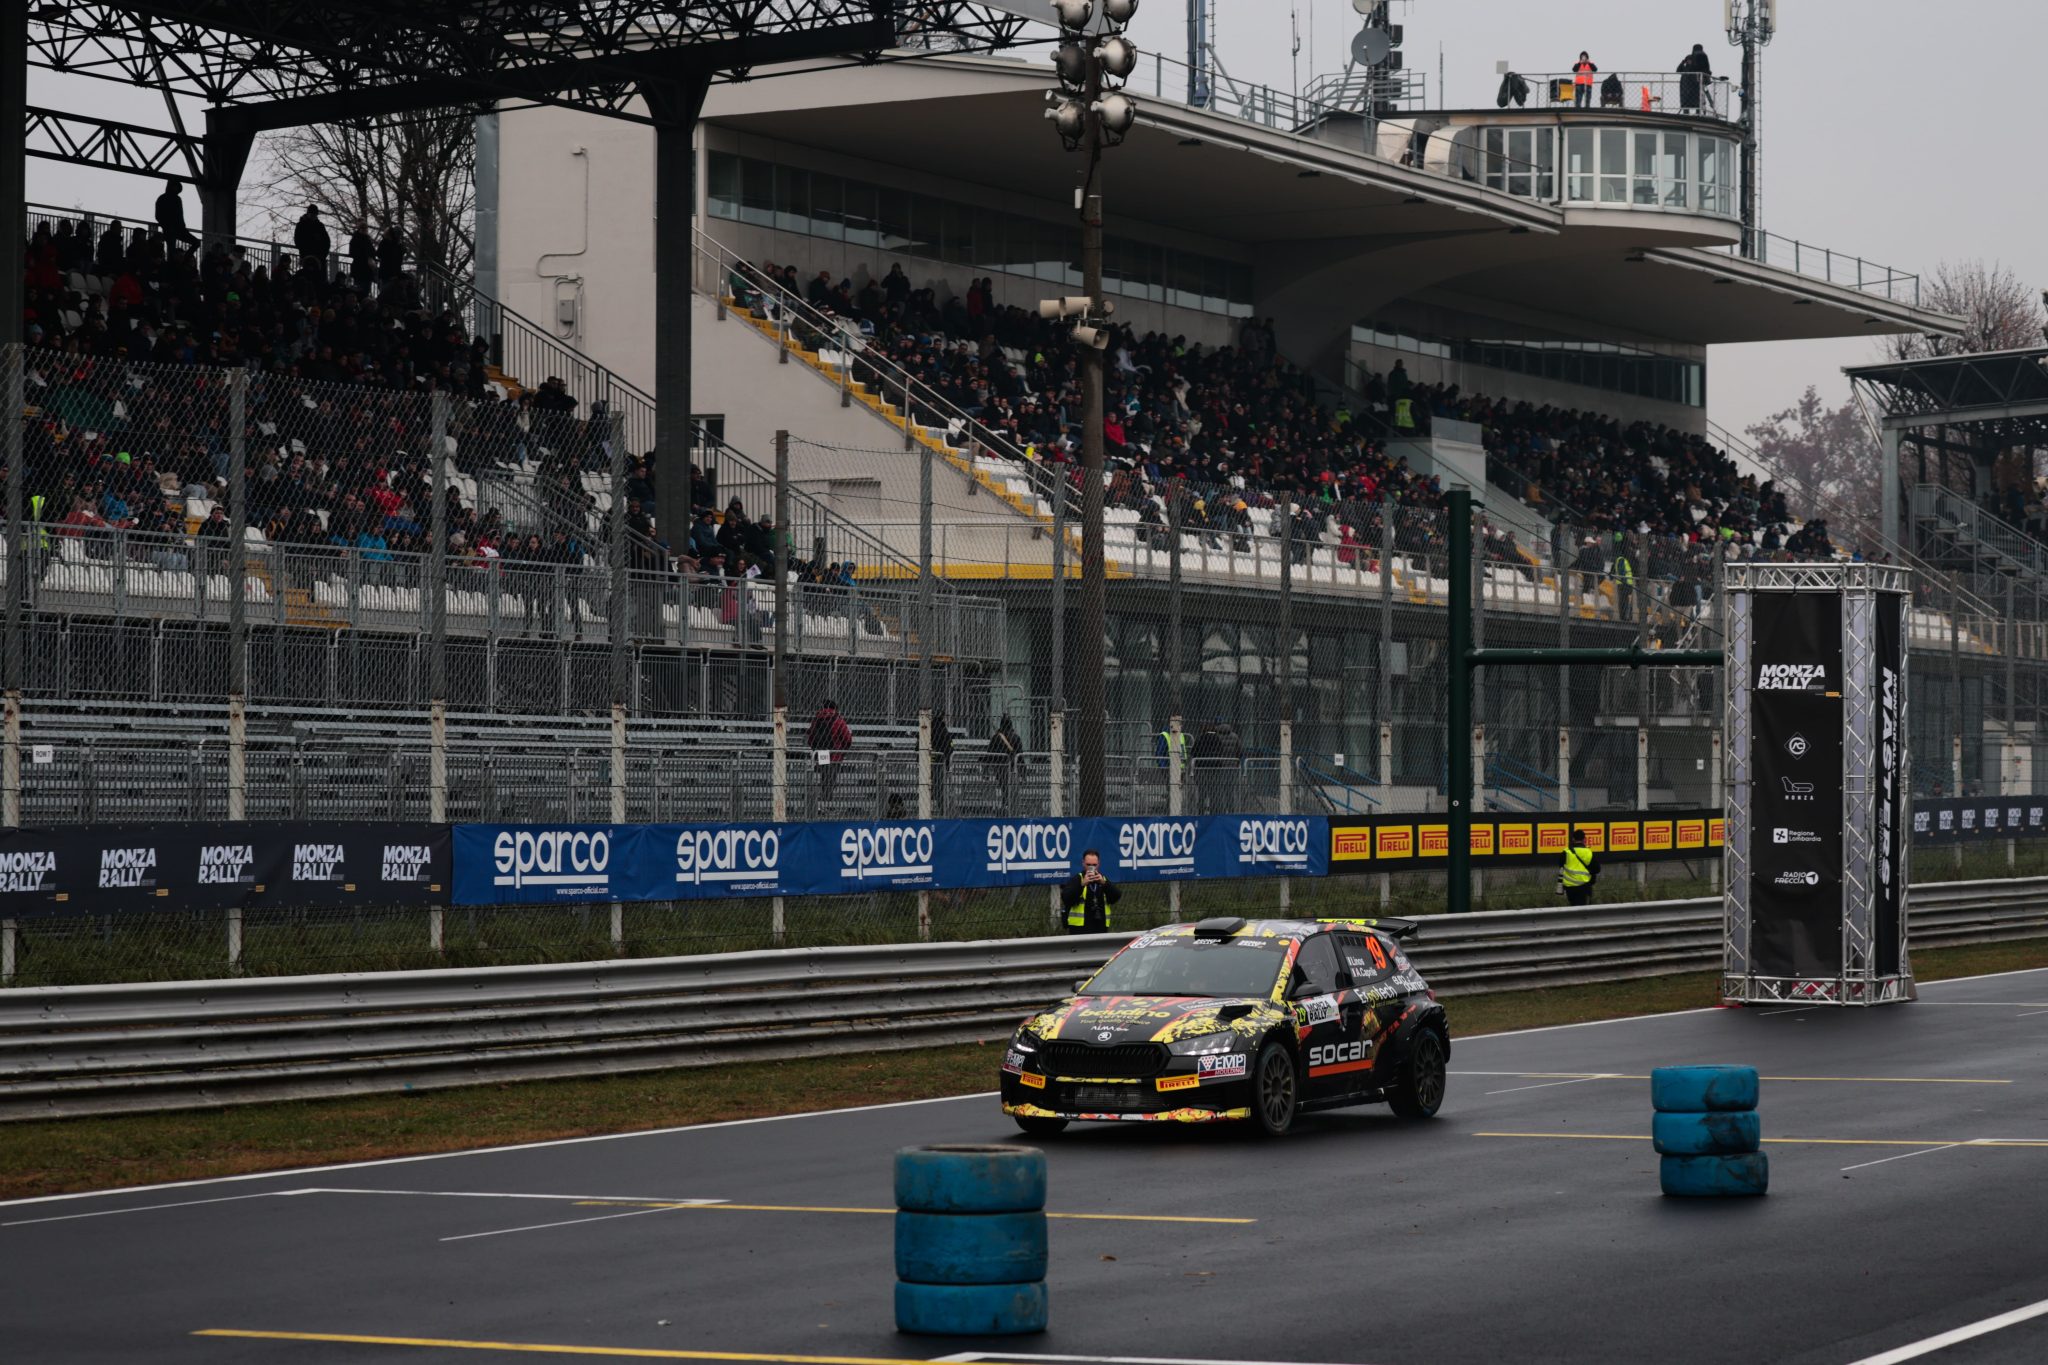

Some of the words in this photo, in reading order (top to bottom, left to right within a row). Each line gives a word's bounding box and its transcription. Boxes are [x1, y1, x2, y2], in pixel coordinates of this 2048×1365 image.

[1760, 664, 1825, 678] MONZA
[1757, 677, 1812, 690] RALLY
[1239, 819, 1308, 864] sparco
[1335, 834, 1367, 854] PIRELLI
[1379, 832, 1410, 852] PIRELLI
[1502, 829, 1530, 848] PIRELLI
[1540, 828, 1566, 847] PIRELLI
[1611, 827, 1637, 845] PIRELLI
[1645, 826, 1670, 844] PIRELLI
[1679, 825, 1702, 843] PIRELLI
[200, 845, 254, 865] MONZA
[293, 844, 344, 864] MONZA
[383, 845, 431, 865] MONZA
[840, 826, 933, 879] sparco
[987, 824, 1070, 874] sparco
[1119, 821, 1196, 869] sparco
[0, 851, 56, 873] MONZA
[101, 848, 157, 869] MONZA
[494, 831, 609, 889] sparco
[676, 829, 779, 885] sparco
[98, 867, 145, 889] RALLY
[198, 864, 243, 884] RALLY
[292, 863, 335, 881] RALLY
[381, 863, 424, 882] RALLY
[1365, 935, 1387, 970] 19
[1310, 1010, 1328, 1022] RALLY
[1309, 1039, 1373, 1067] socar
[1023, 1073, 1043, 1086] PIRELLI
[1159, 1077, 1195, 1088] PIRELLI
